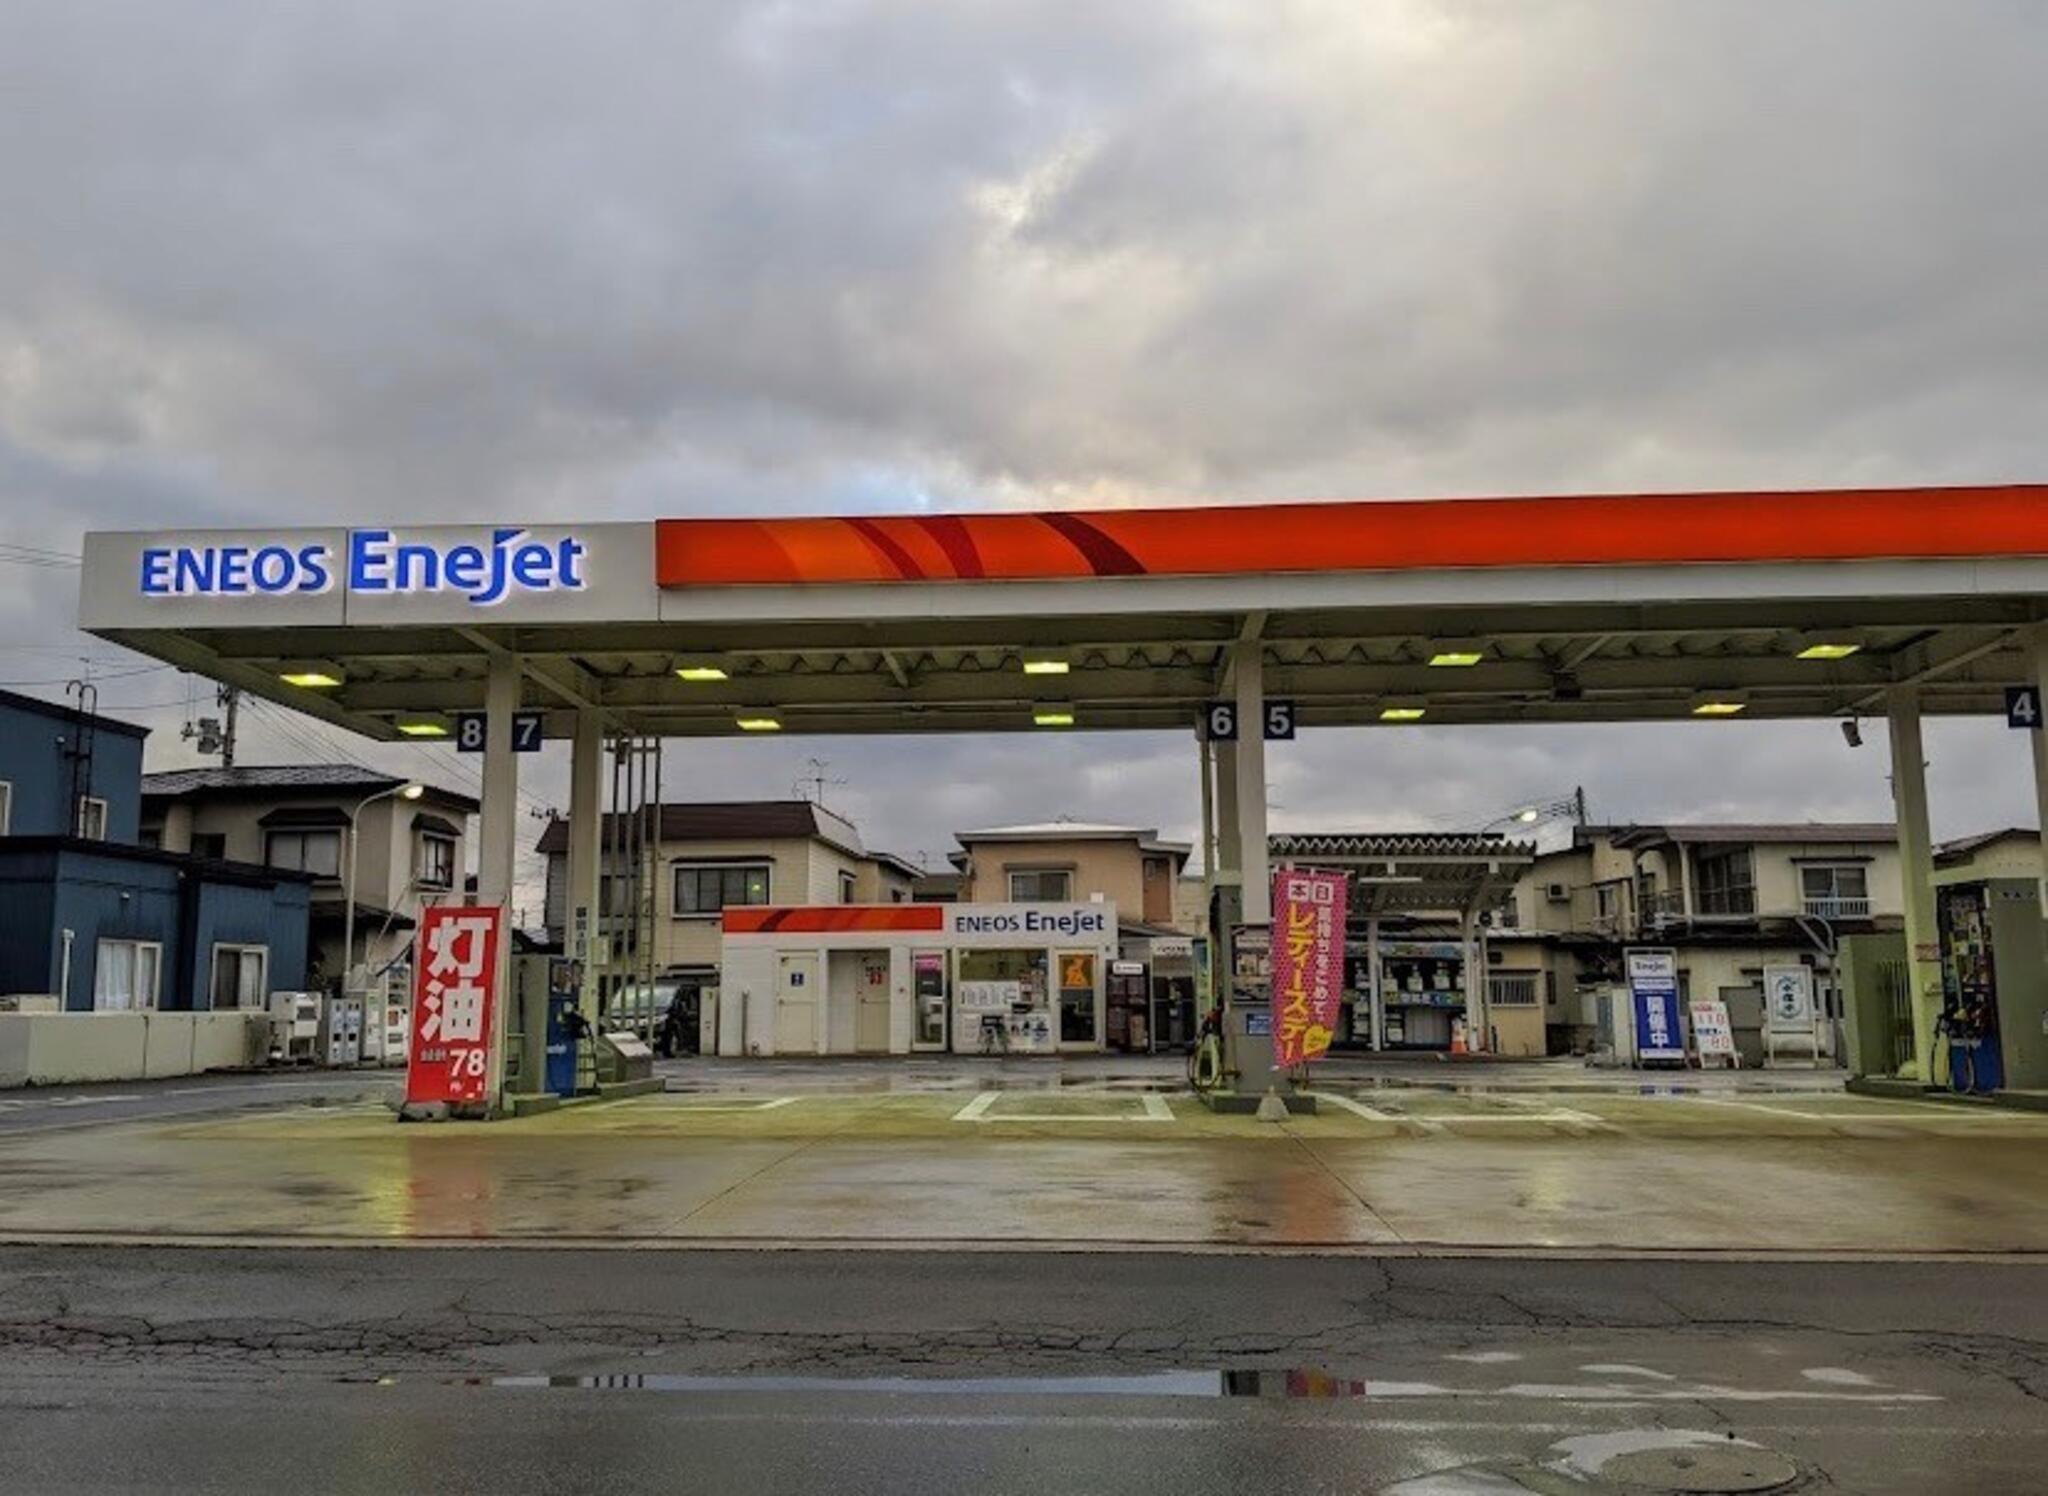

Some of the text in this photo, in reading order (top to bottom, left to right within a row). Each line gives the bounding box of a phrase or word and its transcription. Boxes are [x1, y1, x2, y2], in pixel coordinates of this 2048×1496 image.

[141, 528, 582, 602] ENEOS Enejet
[1211, 707, 1232, 735] 6
[1269, 706, 1290, 735] 5
[2013, 692, 2035, 722] 4
[462, 719, 481, 747] 8
[517, 719, 537, 746] 7
[956, 910, 1104, 935] ENEOS Enejet
[420, 917, 493, 1042] 灯油
[1281, 902, 1314, 1060] レディースデー
[450, 1048, 485, 1077] 78
